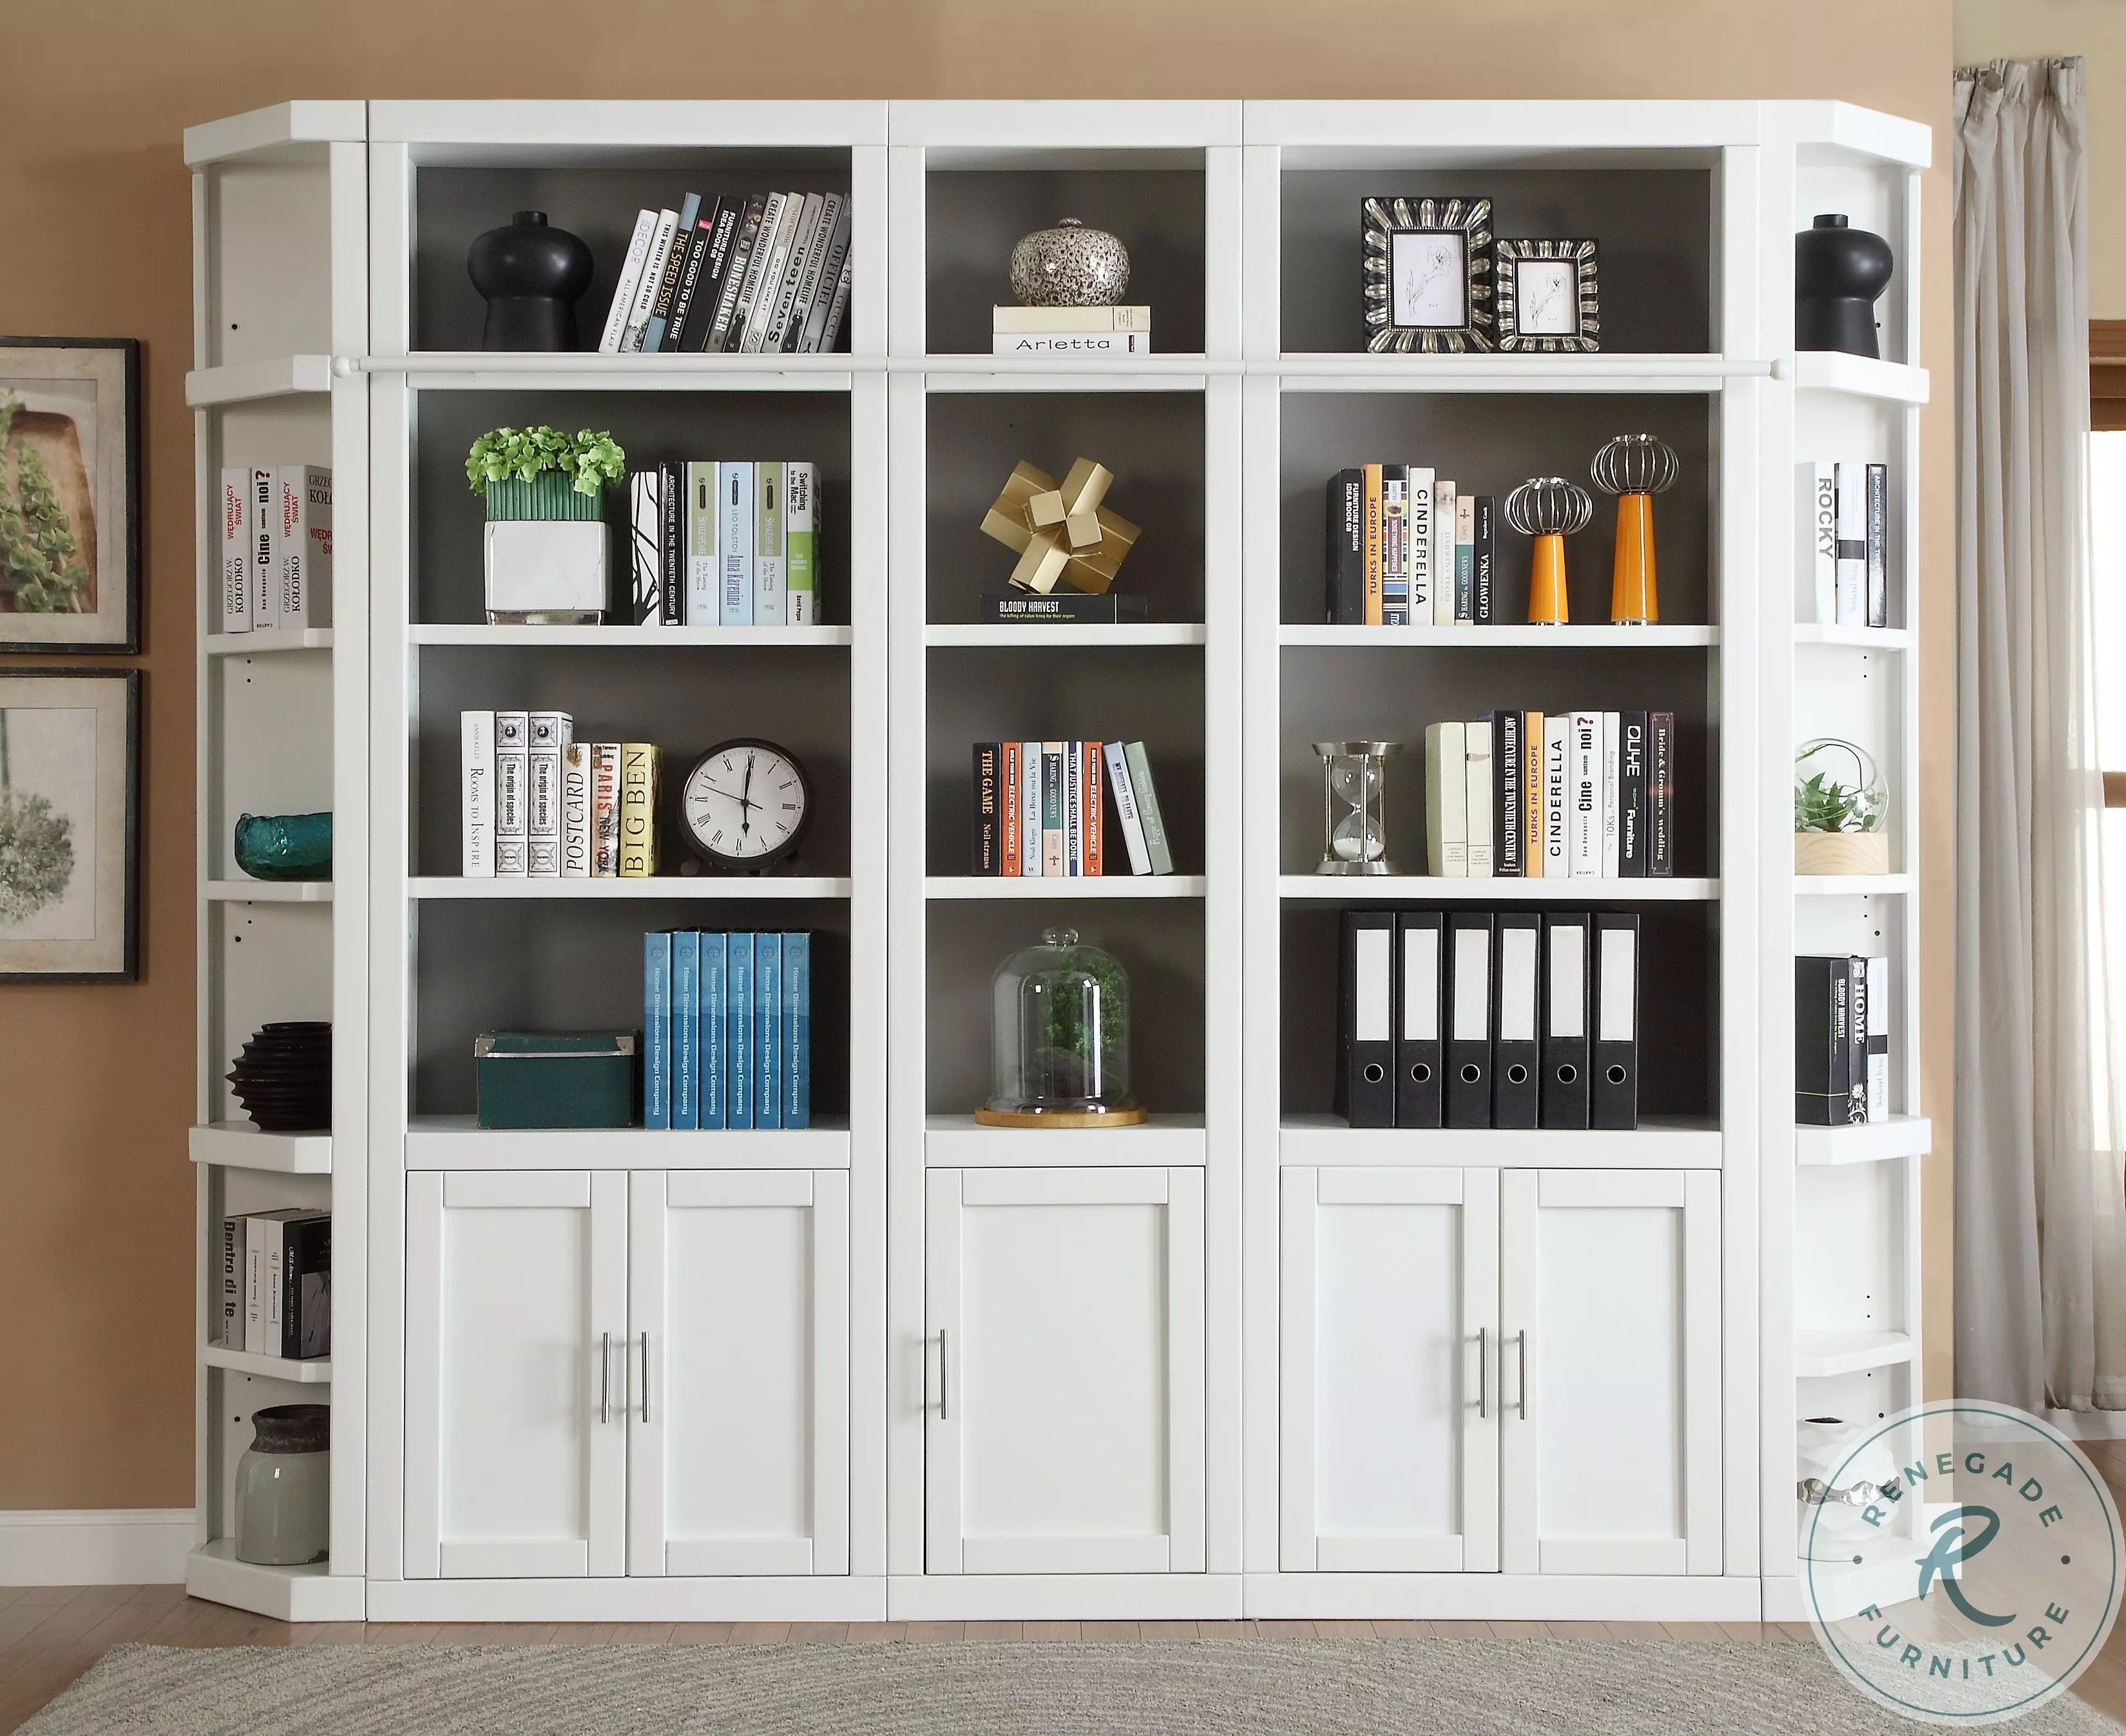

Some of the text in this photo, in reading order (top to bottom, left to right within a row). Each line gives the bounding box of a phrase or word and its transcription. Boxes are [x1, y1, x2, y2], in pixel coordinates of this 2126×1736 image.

[767, 199, 779, 225] CREATE
[663, 224, 671, 237] THIS
[710, 209, 729, 259] IDEA BOOK 08
[711, 211, 736, 280] FURNITURE DESIGN
[754, 225, 771, 269] WONDERFUL
[655, 238, 667, 262] WINTER
[799, 200, 836, 305] CREATE WONDERFUL HOMELIFE
[646, 285, 652, 294] SO
[648, 272, 656, 285] NOT
[655, 233, 689, 317] THE SPEED ISSUE
[669, 239, 704, 340] TOO GOOD TO BE TRUE
[742, 269, 758, 304] HOMELIFE
[817, 244, 843, 308] OFFICIEL
[640, 294, 650, 310] COLD
[714, 256, 747, 332] BONESHAKER
[826, 295, 844, 339] GUCCI
[1015, 339, 1110, 350] Arletta
[667, 475, 676, 523] ARCHITECTURE
[790, 486, 798, 504] Mac
[798, 472, 808, 511] Switching
[1345, 522, 1352, 532] 08
[1818, 478, 1833, 559] ROCKY
[667, 534, 676, 547] THE
[1370, 544, 1376, 556] IN
[1415, 489, 1428, 605] CINDERELLA
[727, 555, 743, 572] Anna
[235, 558, 244, 615] KOŁODKO
[292, 556, 300, 612] KOŁODKO
[727, 574, 743, 606] Karenina
[999, 601, 1060, 612] BLOODY HARVEST
[507, 764, 515, 775] The
[539, 764, 548, 775] The
[1658, 758, 1665, 768] &
[505, 776, 515, 794] origin
[538, 776, 548, 794] origin
[597, 763, 613, 812] PARIS
[981, 750, 993, 814] THE GAME
[1031, 780, 1036, 790] ou
[1550, 739, 1562, 857] CINDERELLA
[1578, 781, 1593, 811] Cine
[506, 801, 515, 825] species
[538, 801, 548, 825] species
[625, 750, 646, 873] BIG BEN
[1030, 811, 1036, 820] La
[1531, 793, 1538, 805] IN
[566, 772, 584, 872] POSTCARD
[1606, 816, 1615, 837] 10Ks
[1625, 809, 1636, 859] Furniture
[1657, 819, 1665, 861] wedding
[1837, 978, 1846, 1039] BLOODY HARVEST
[1854, 984, 1865, 1044] HOME
[224, 1221, 236, 1318] Dentro di te
